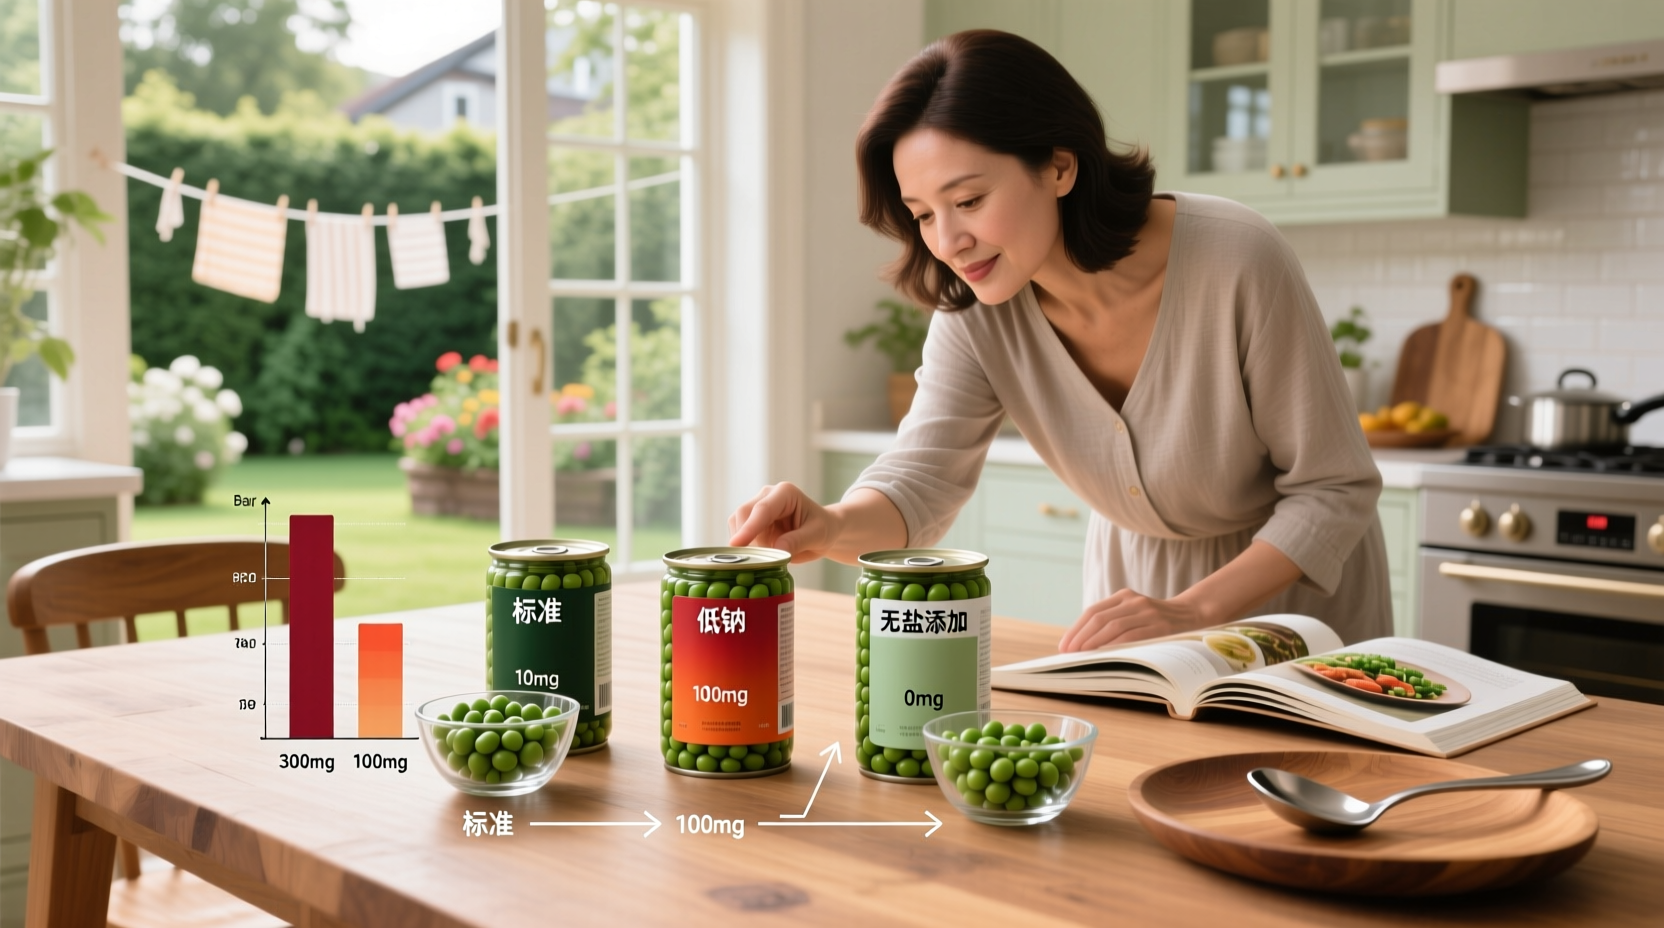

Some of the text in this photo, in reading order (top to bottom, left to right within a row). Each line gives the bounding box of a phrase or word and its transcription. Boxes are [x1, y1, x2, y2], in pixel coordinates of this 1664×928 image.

[512, 596, 562, 625] 标准
[697, 606, 746, 634] 低钠
[880, 608, 968, 634] 无盐添加
[515, 669, 559, 690] 10mg
[692, 685, 748, 707] 100mg
[904, 689, 944, 711] 0mg
